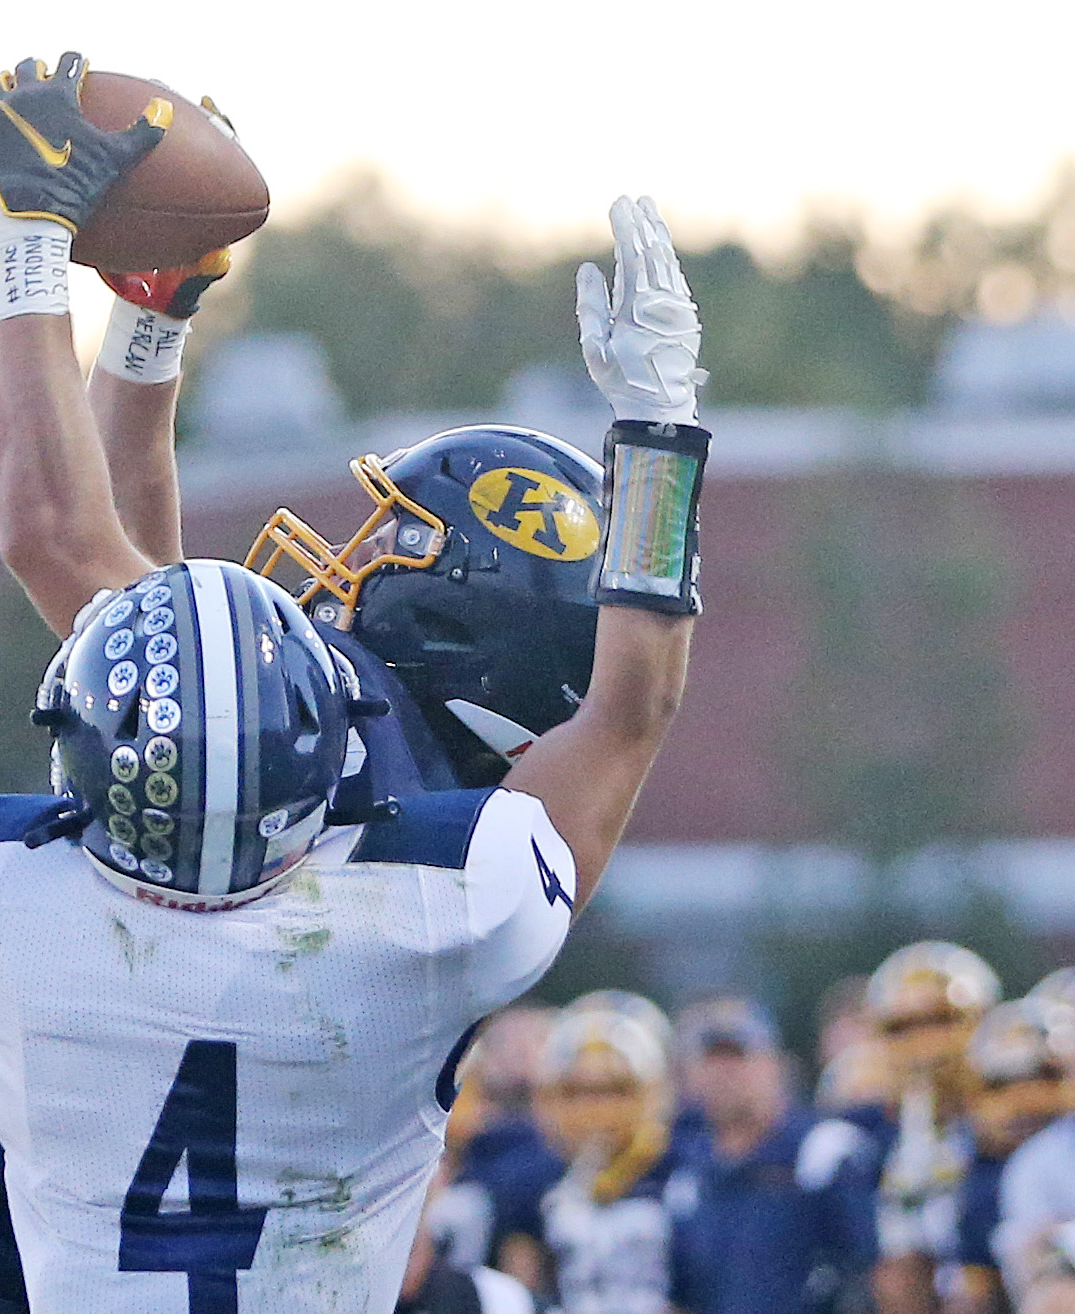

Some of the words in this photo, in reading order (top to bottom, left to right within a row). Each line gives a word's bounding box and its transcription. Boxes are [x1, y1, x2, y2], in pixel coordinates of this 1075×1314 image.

[24, 235, 48, 297] STRONG
[154, 327, 179, 357] ALL
[486, 471, 586, 555] K
[530, 832, 574, 912] 4
